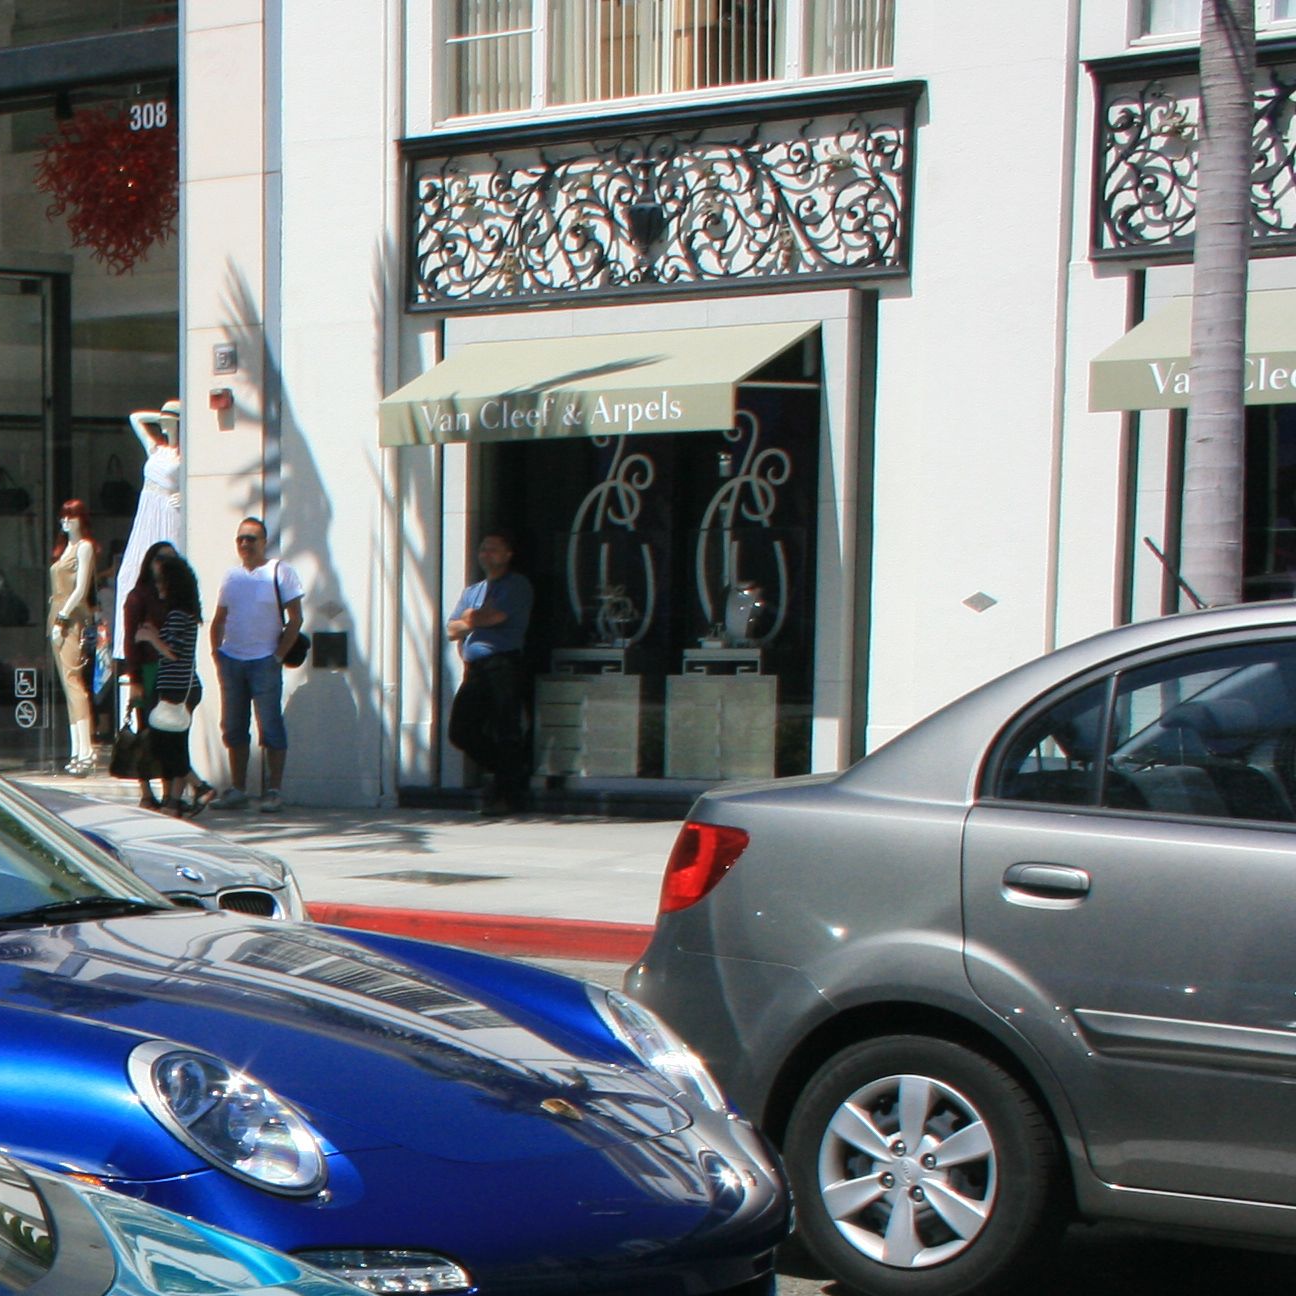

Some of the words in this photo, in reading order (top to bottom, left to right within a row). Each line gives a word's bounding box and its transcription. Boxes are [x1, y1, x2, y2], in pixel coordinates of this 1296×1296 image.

[130, 102, 168, 131] 308
[1148, 362, 1191, 394] Va
[421, 404, 470, 432] Van
[480, 397, 555, 430] Cleef
[562, 401, 583, 426] &
[590, 390, 683, 432] Arpels
